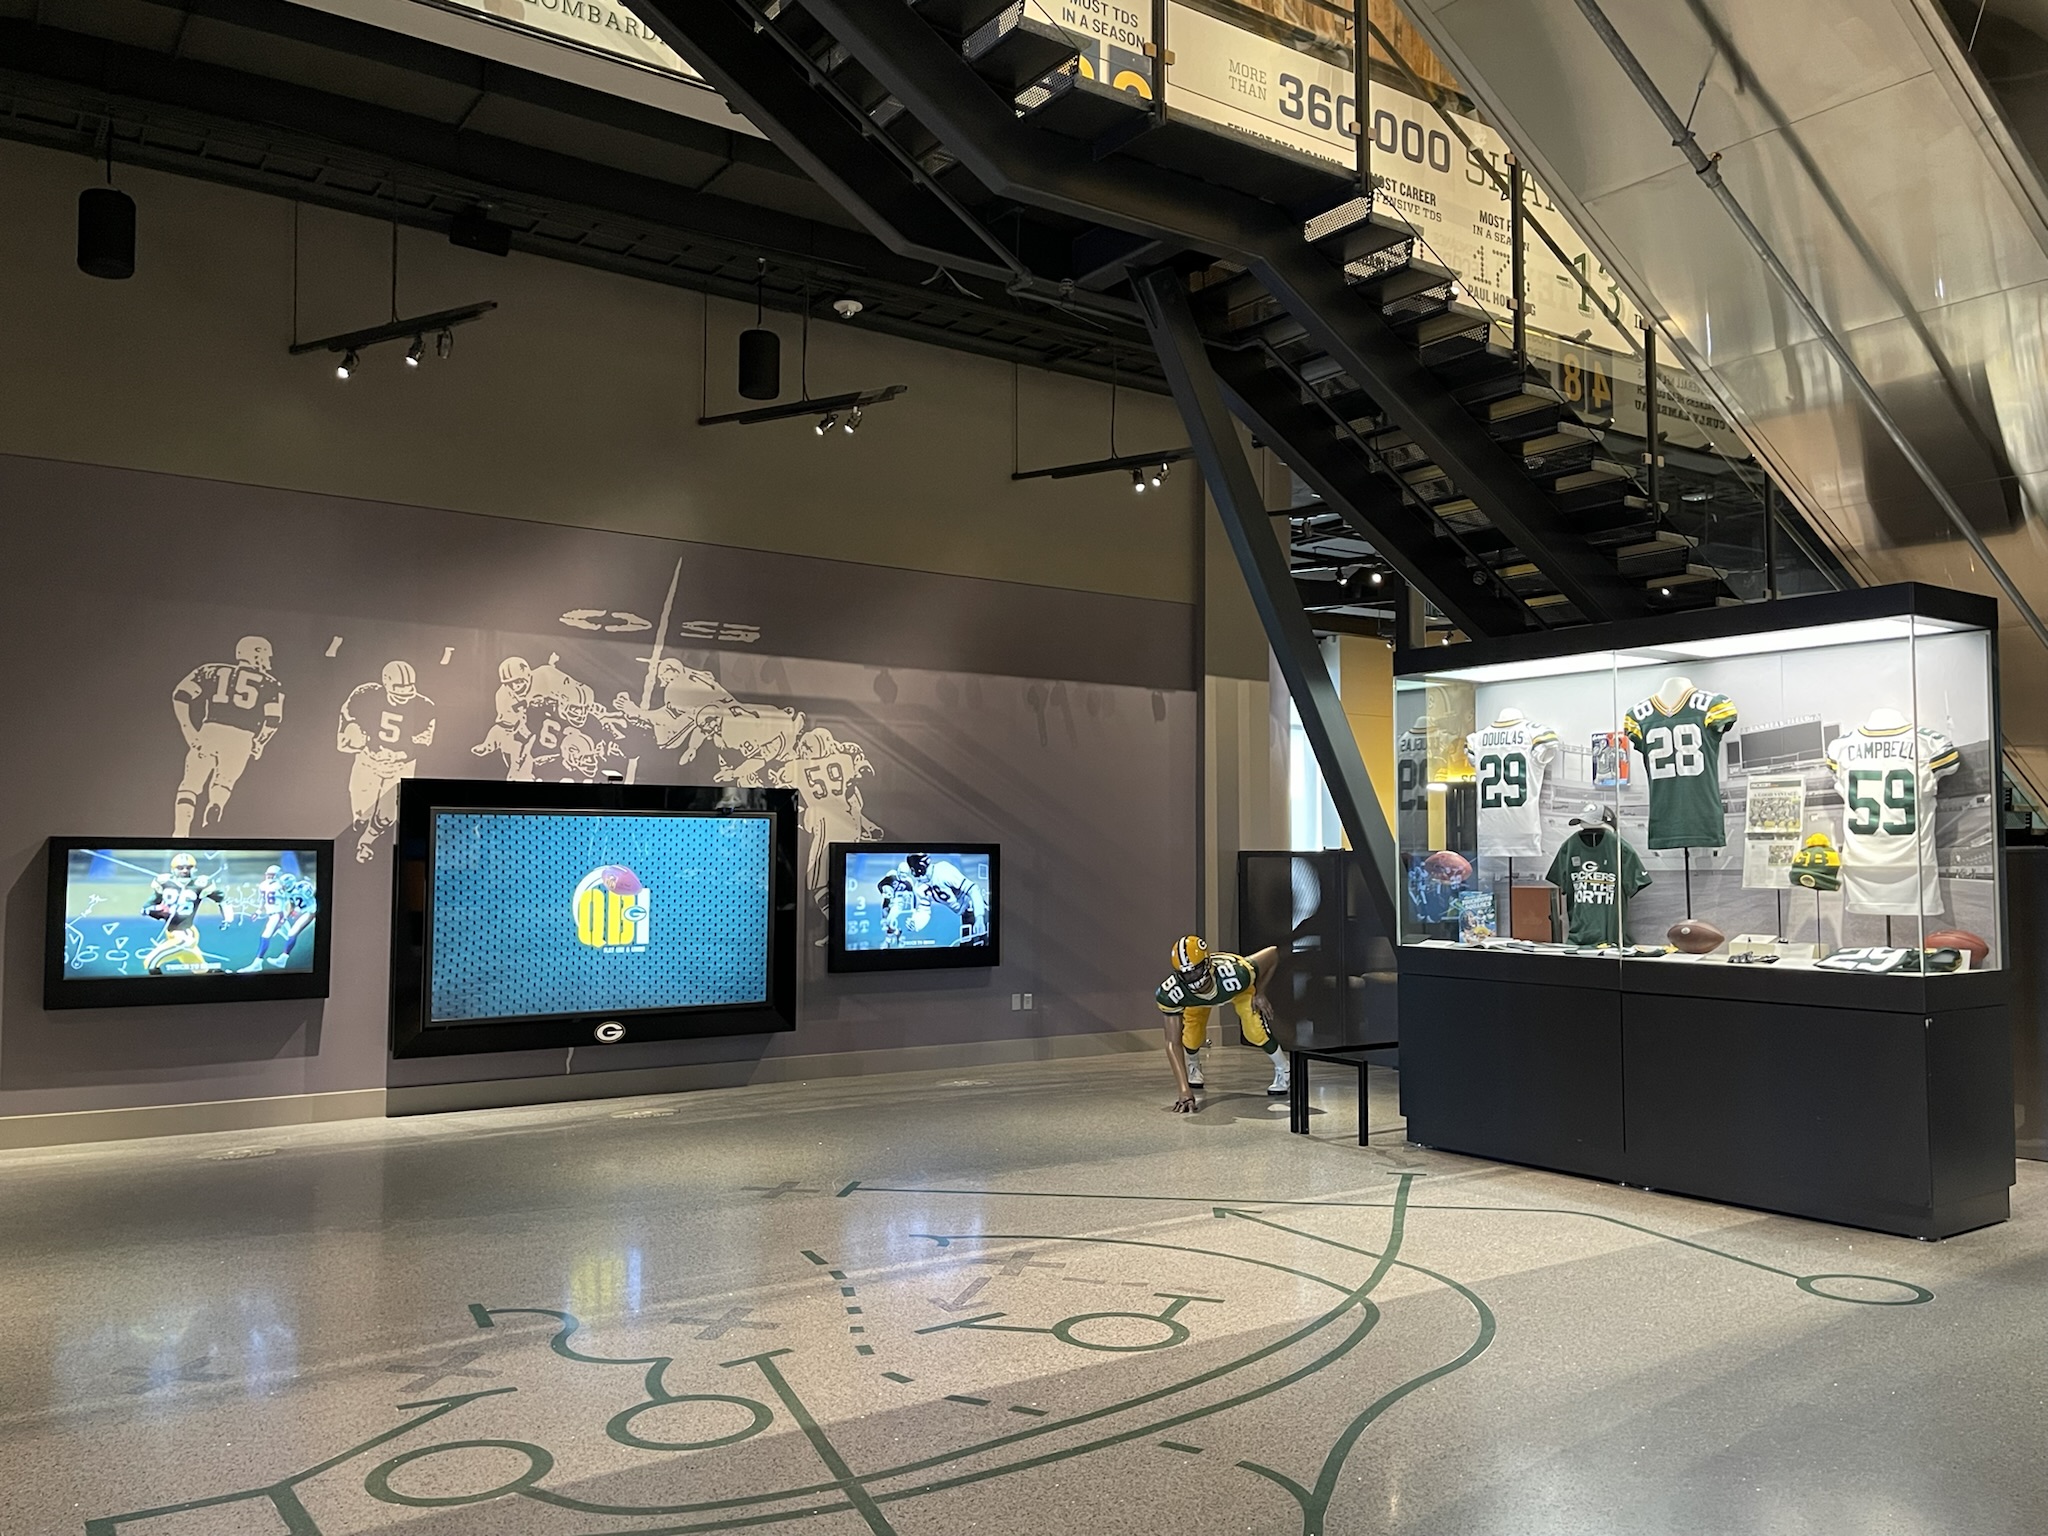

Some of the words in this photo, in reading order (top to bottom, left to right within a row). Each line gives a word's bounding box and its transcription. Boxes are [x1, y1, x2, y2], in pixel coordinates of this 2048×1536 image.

[1062, 7, 1076, 24] IN
[1080, 14, 1088, 29] A
[1092, 19, 1145, 48] SEASON
[1113, 8, 1139, 28] TDS
[1228, 59, 1267, 85] MORE
[1228, 76, 1267, 101] THAN
[1278, 72, 1450, 173] 360000
[1399, 182, 1436, 207] CAREER
[1422, 207, 1442, 223] TDS
[1479, 209, 1505, 230] MOST
[1473, 224, 1483, 236] IN
[1486, 229, 1492, 240] A
[1468, 284, 1491, 303] PAUL
[379, 711, 403, 743] 5
[1482, 731, 1523, 747] DOUGLAS
[1646, 723, 1704, 779] 28
[1848, 741, 1915, 761] CAMPBELL
[805, 763, 844, 799] 59
[1480, 752, 1527, 808] 29
[1848, 769, 1916, 836] 59
[1581, 861, 1599, 872] G
[1590, 882, 1615, 892] THE
[596, 1022, 624, 1042] G
